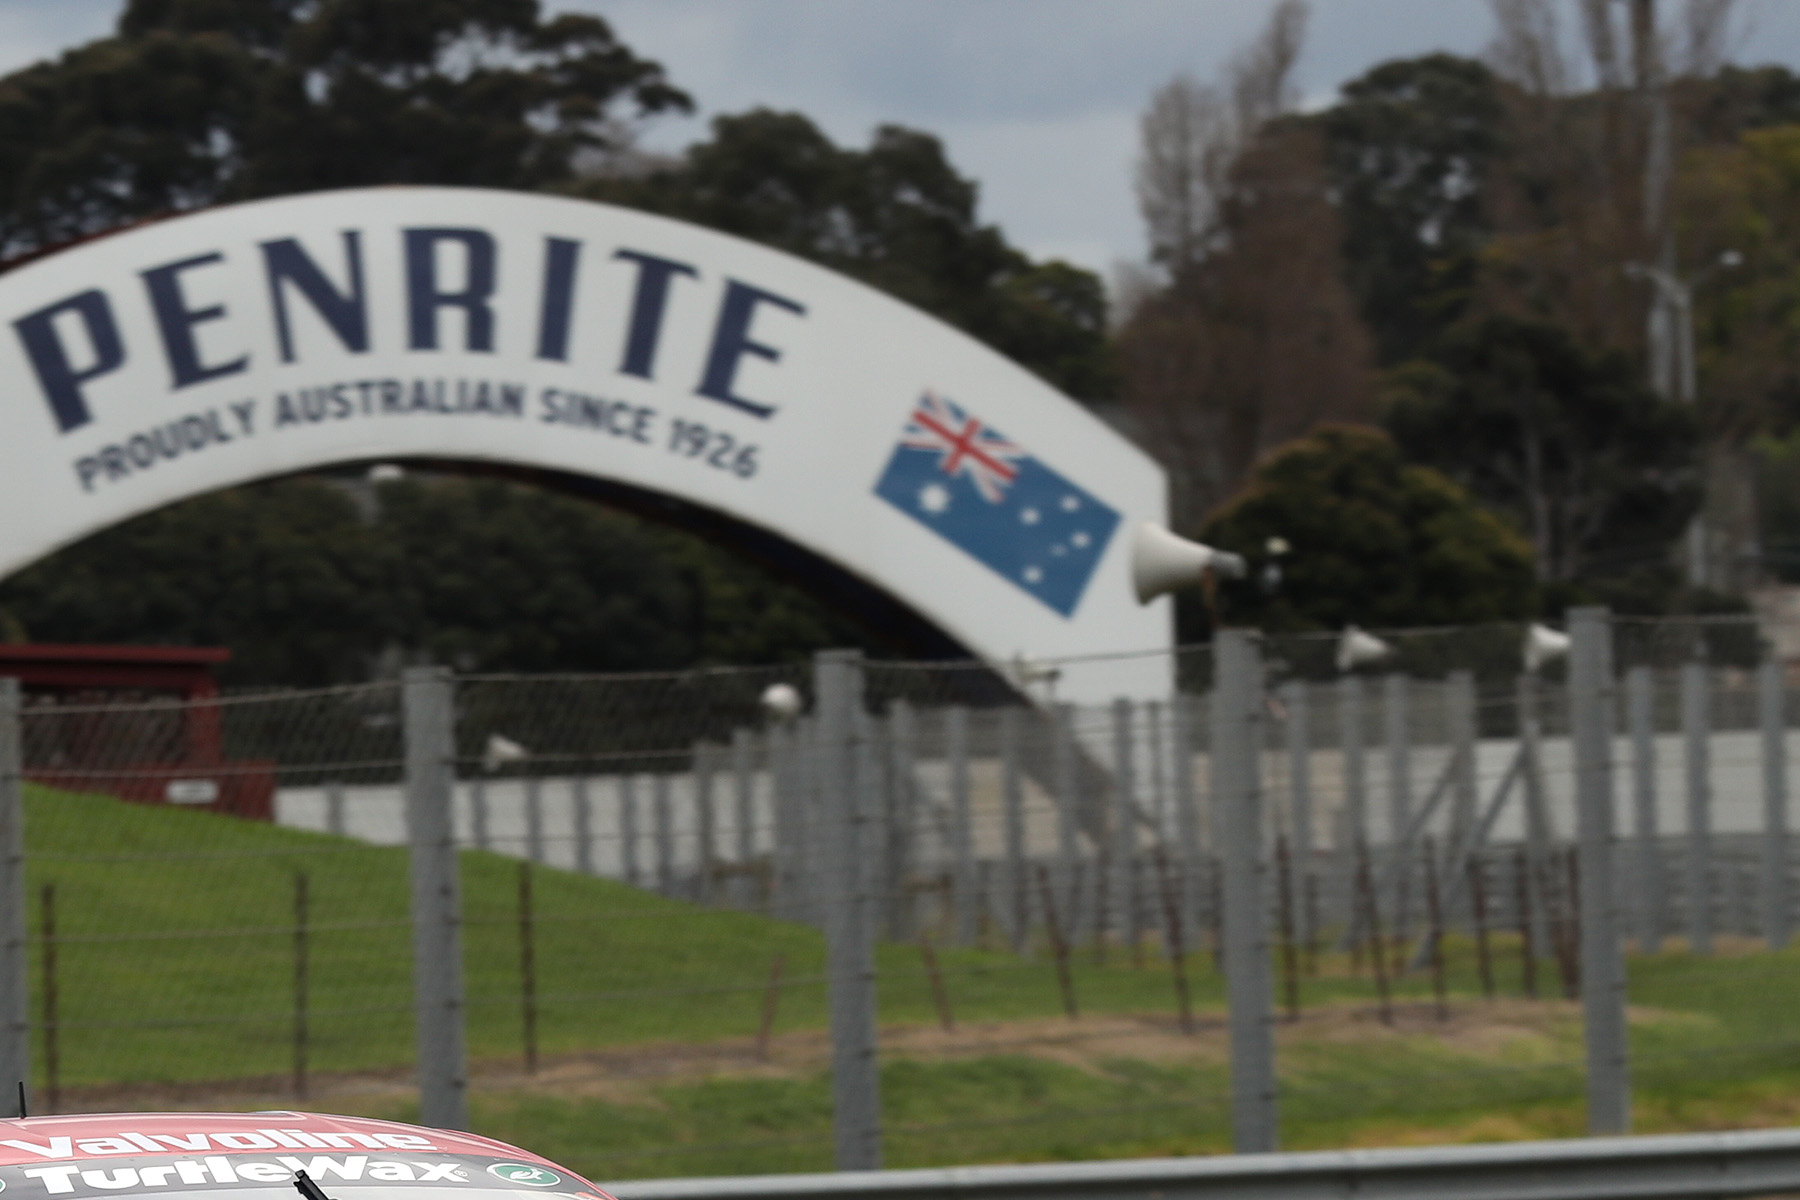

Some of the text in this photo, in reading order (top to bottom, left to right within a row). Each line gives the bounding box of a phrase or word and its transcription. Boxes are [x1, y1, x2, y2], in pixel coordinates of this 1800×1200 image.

[8, 226, 809, 436] PENRITE
[73, 377, 760, 493] PROUDLY AUSTRALIAN SINCE 1926
